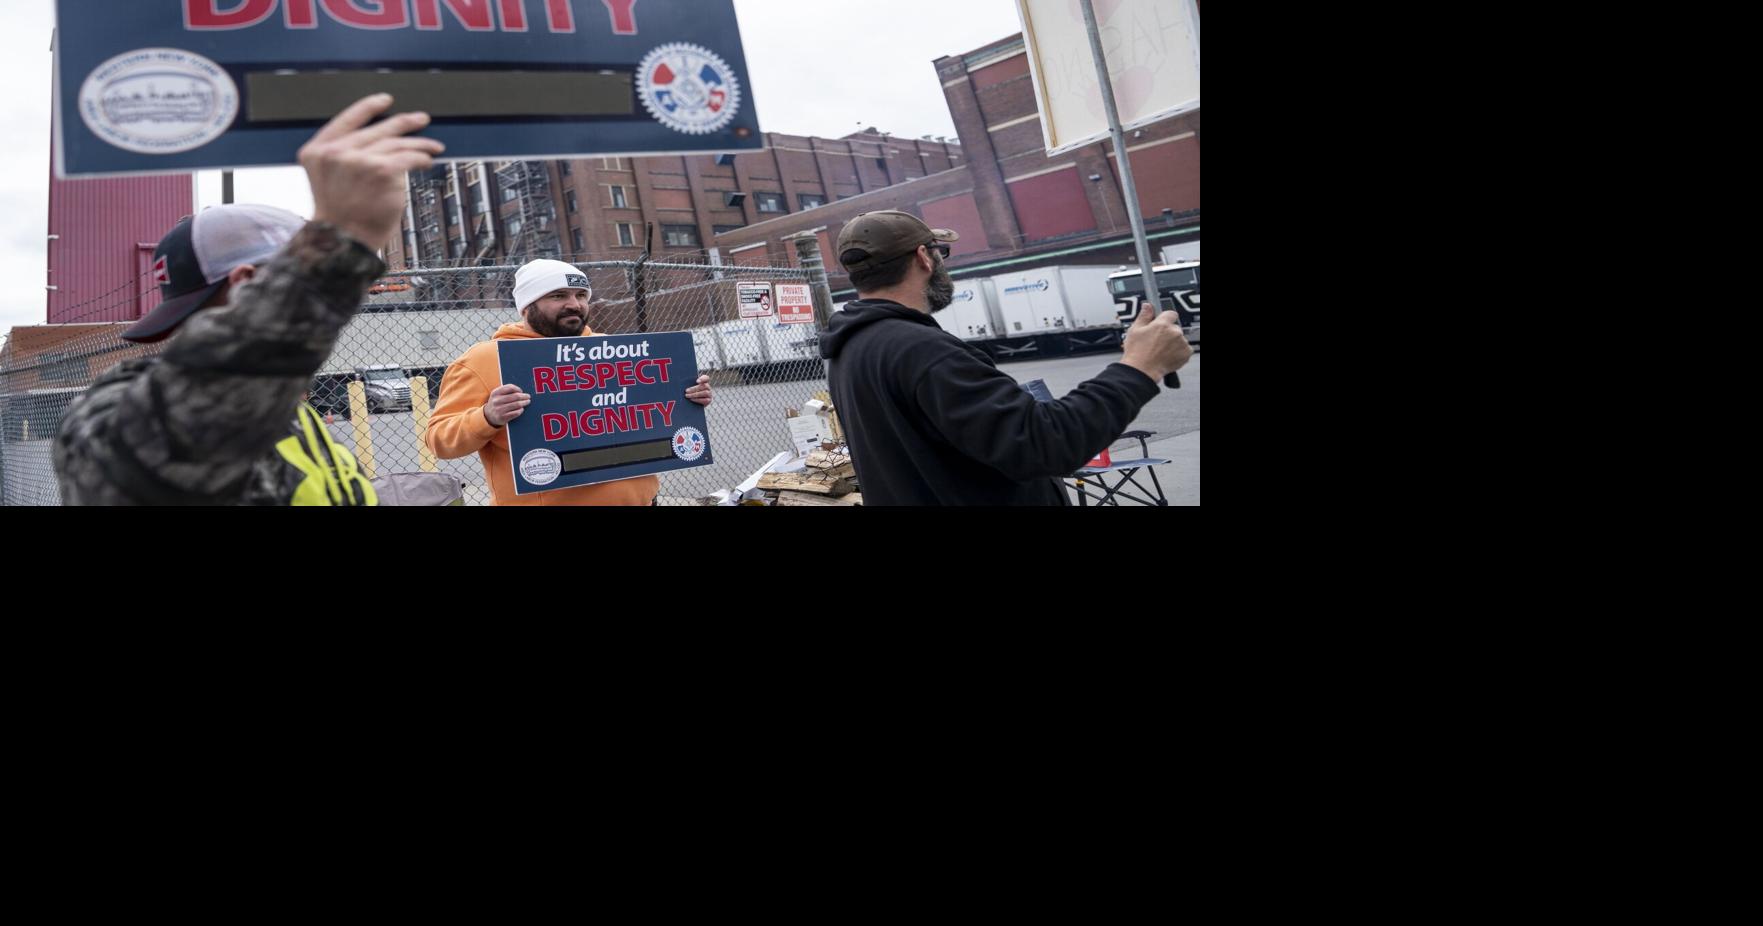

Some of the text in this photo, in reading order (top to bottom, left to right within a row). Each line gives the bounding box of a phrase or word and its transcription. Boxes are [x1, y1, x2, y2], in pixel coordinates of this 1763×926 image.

[780, 295, 808, 304] PROPERTY
[782, 286, 804, 295] PRIVATE
[556, 340, 650, 363] It's about
[533, 358, 673, 394] RESPECT
[591, 387, 627, 407] and
[541, 400, 676, 441] DIGNITY
